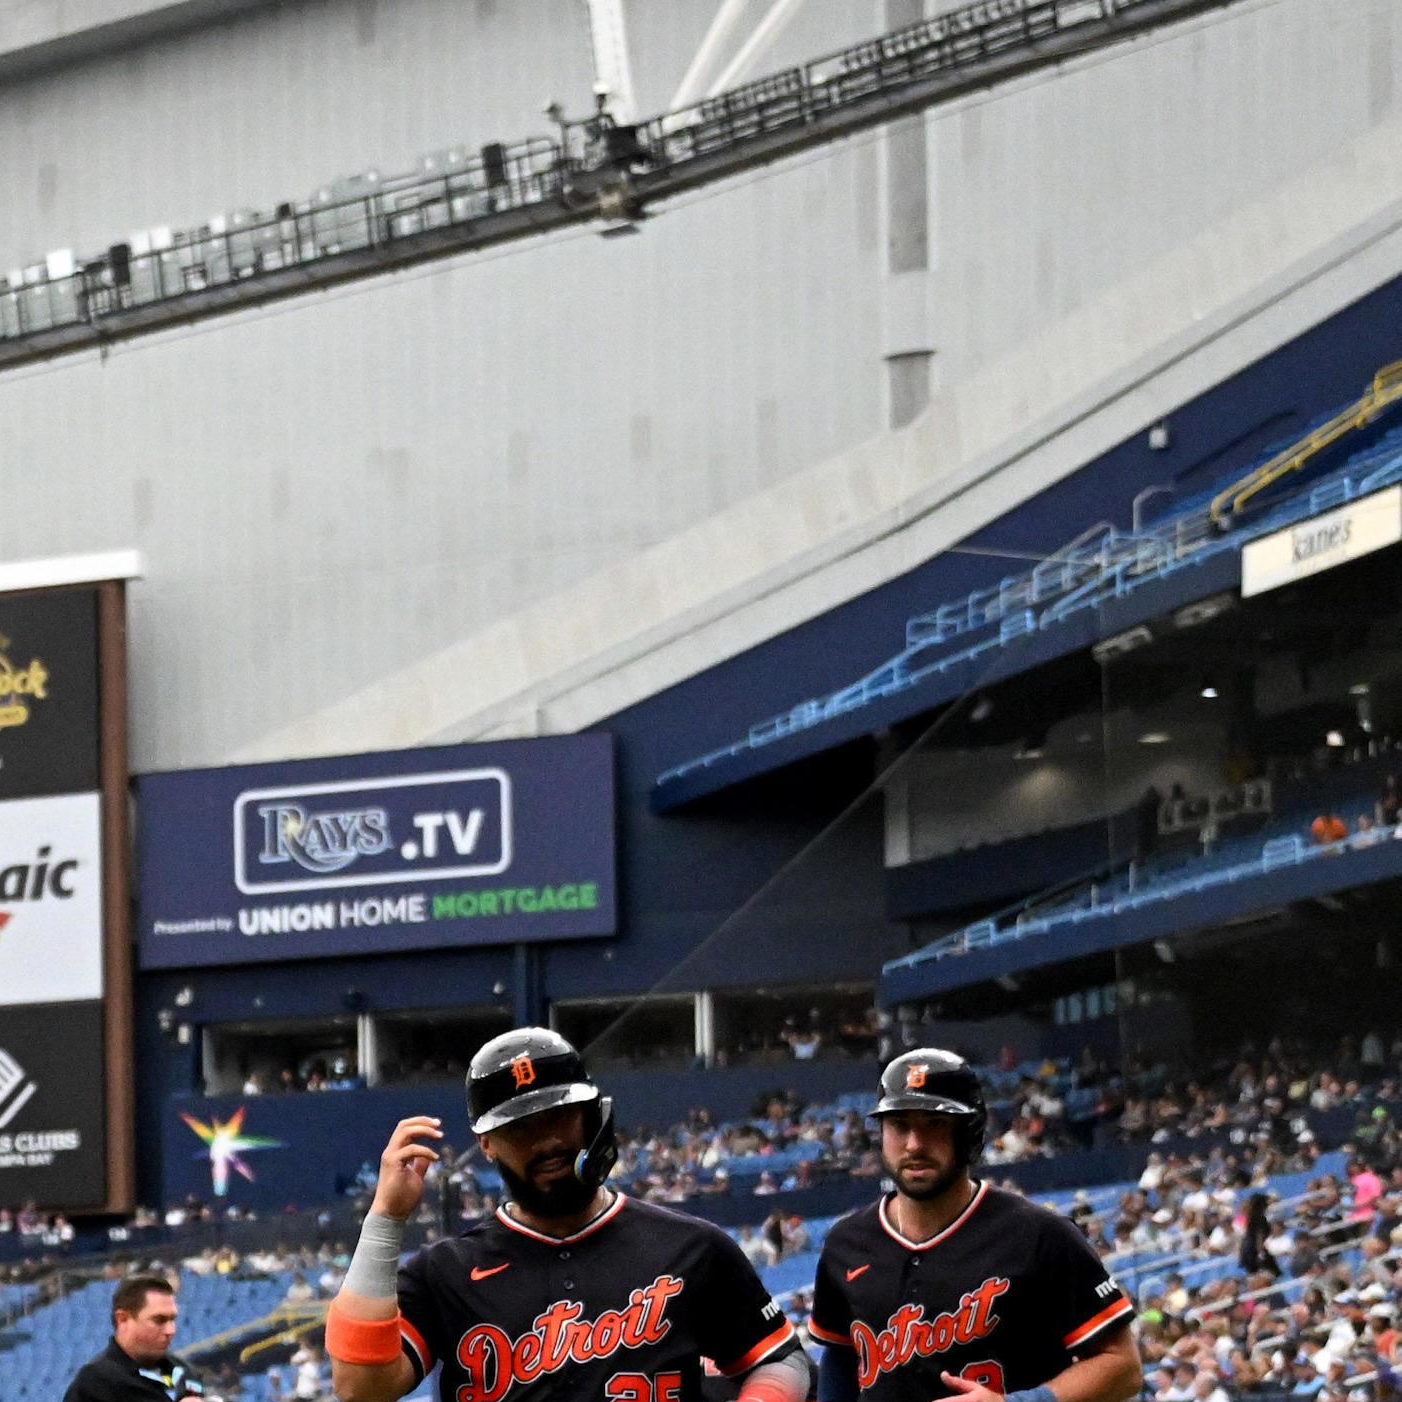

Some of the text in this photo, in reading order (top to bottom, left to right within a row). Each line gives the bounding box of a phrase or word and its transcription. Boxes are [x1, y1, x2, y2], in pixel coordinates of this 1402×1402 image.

[238, 902, 335, 936] UNION
[339, 893, 428, 929] HOME
[432, 882, 598, 921] MORTGAGE
[15, 1128, 82, 1152] CLUBS
[851, 1276, 1011, 1392] Detroit
